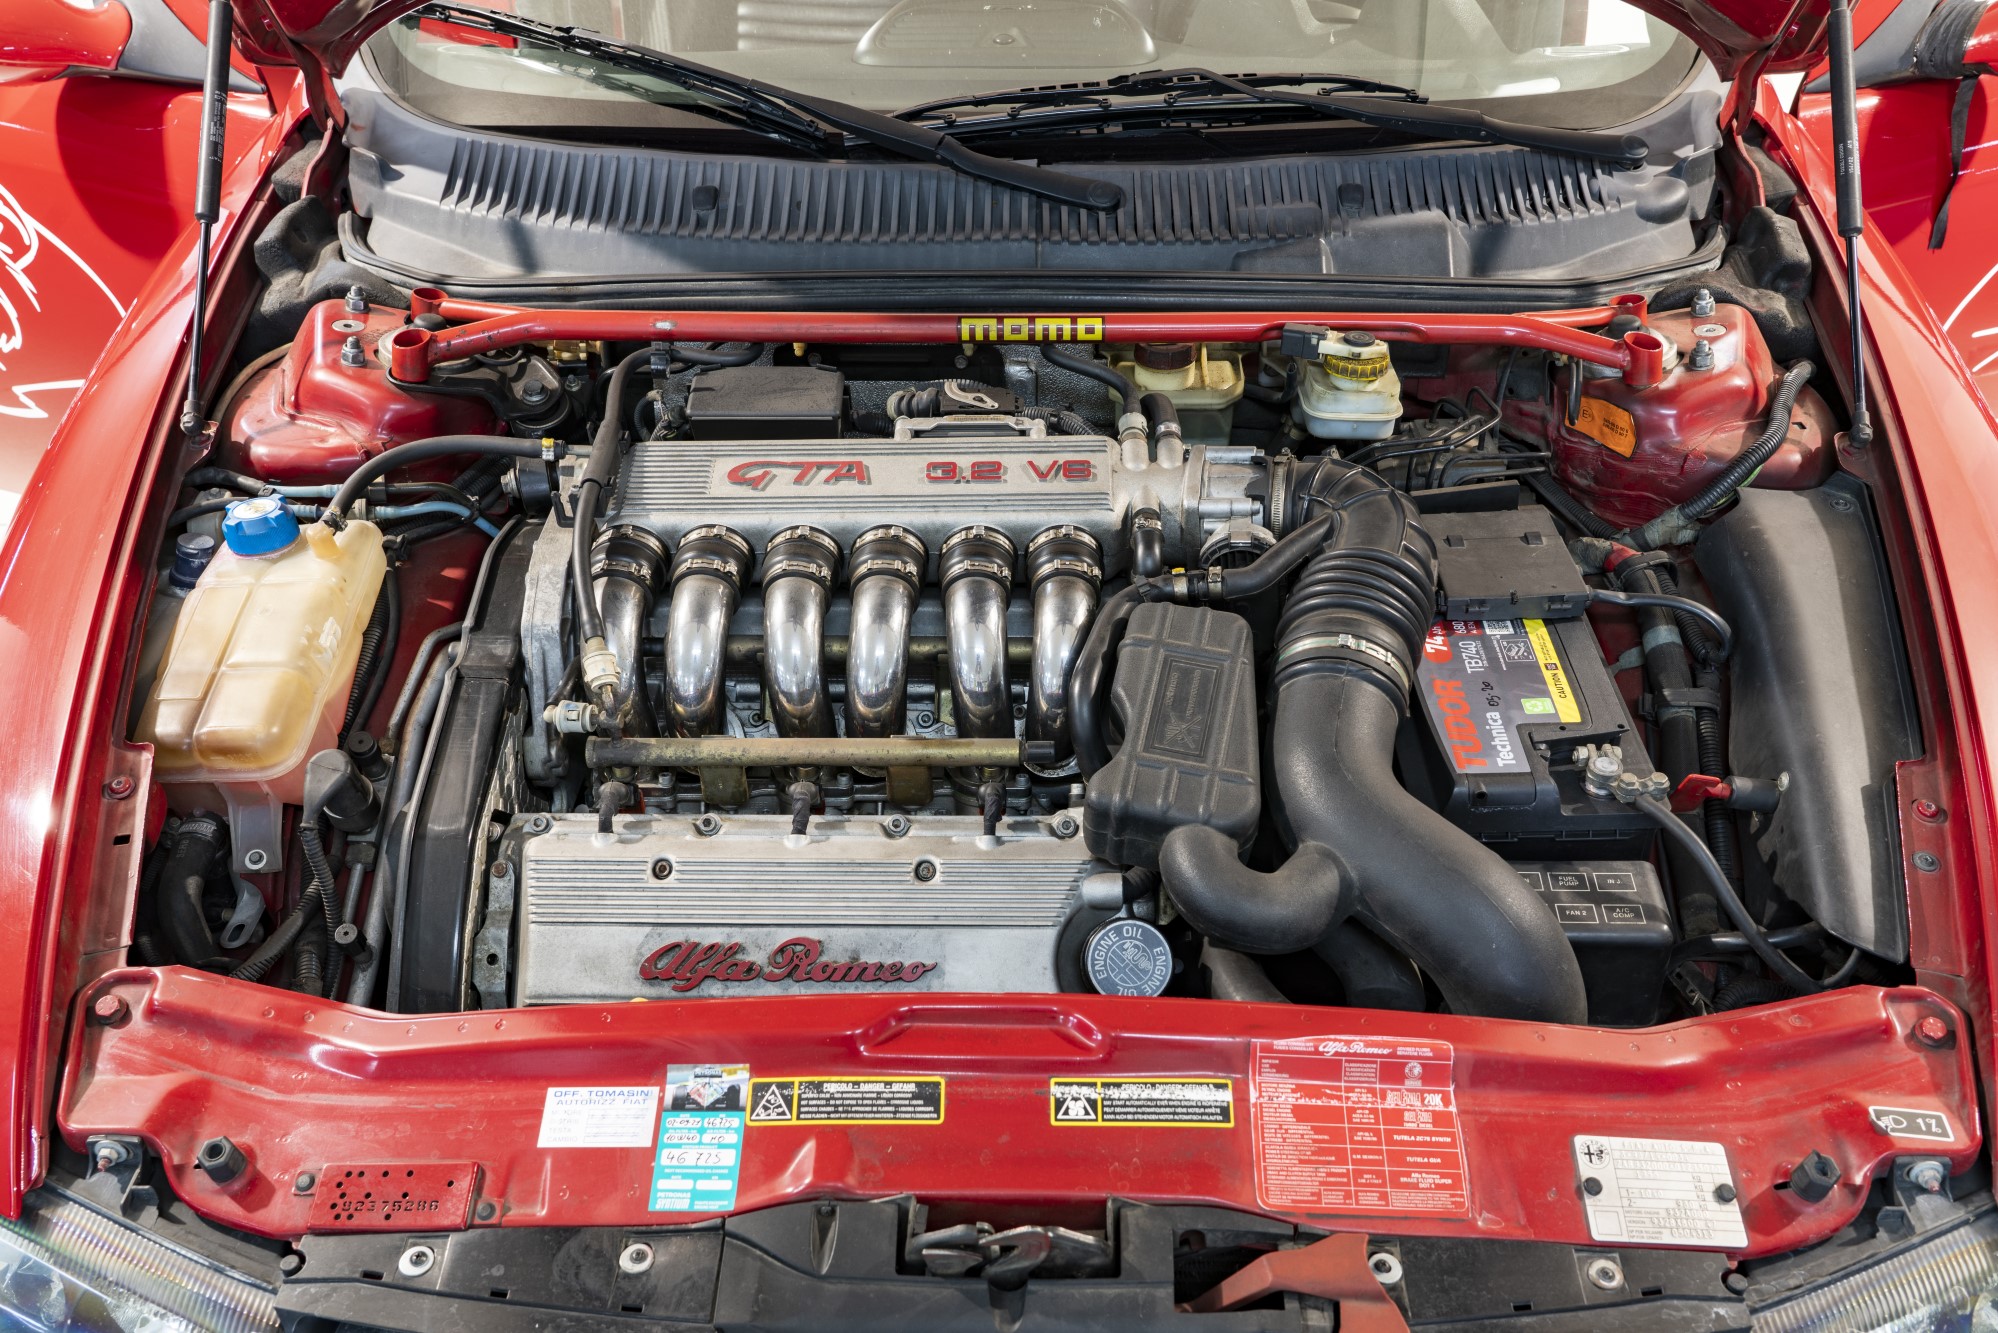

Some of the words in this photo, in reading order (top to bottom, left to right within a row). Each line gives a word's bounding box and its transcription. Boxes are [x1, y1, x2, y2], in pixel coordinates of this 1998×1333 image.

[961, 317, 1103, 341] momo
[727, 460, 869, 491] GTA
[926, 461, 1004, 483] 3.2
[1027, 460, 1093, 483] V6
[1424, 635, 1448, 653] 74
[1458, 641, 1485, 674] TB740
[1551, 672, 1567, 699] CAUTION
[1433, 679, 1488, 770] TUDOR
[1485, 711, 1516, 767] Technica
[639, 941, 761, 992] Alfa
[762, 936, 937, 982] Romeo
[1094, 930, 1119, 979] ENGINE
[1122, 926, 1143, 940] OIL
[1141, 946, 1167, 996] ENGINE
[1318, 1041, 1348, 1056] Alfa
[1349, 1041, 1392, 1055] Romeo
[823, 1083, 853, 1091] PERICOLO
[860, 1083, 885, 1091] DANGER
[892, 1083, 916, 1091] GEFAHR
[1423, 1093, 1443, 1106] 20K
[1916, 1118, 1942, 1133] 1%
[341, 1200, 439, 1212] 92375286
